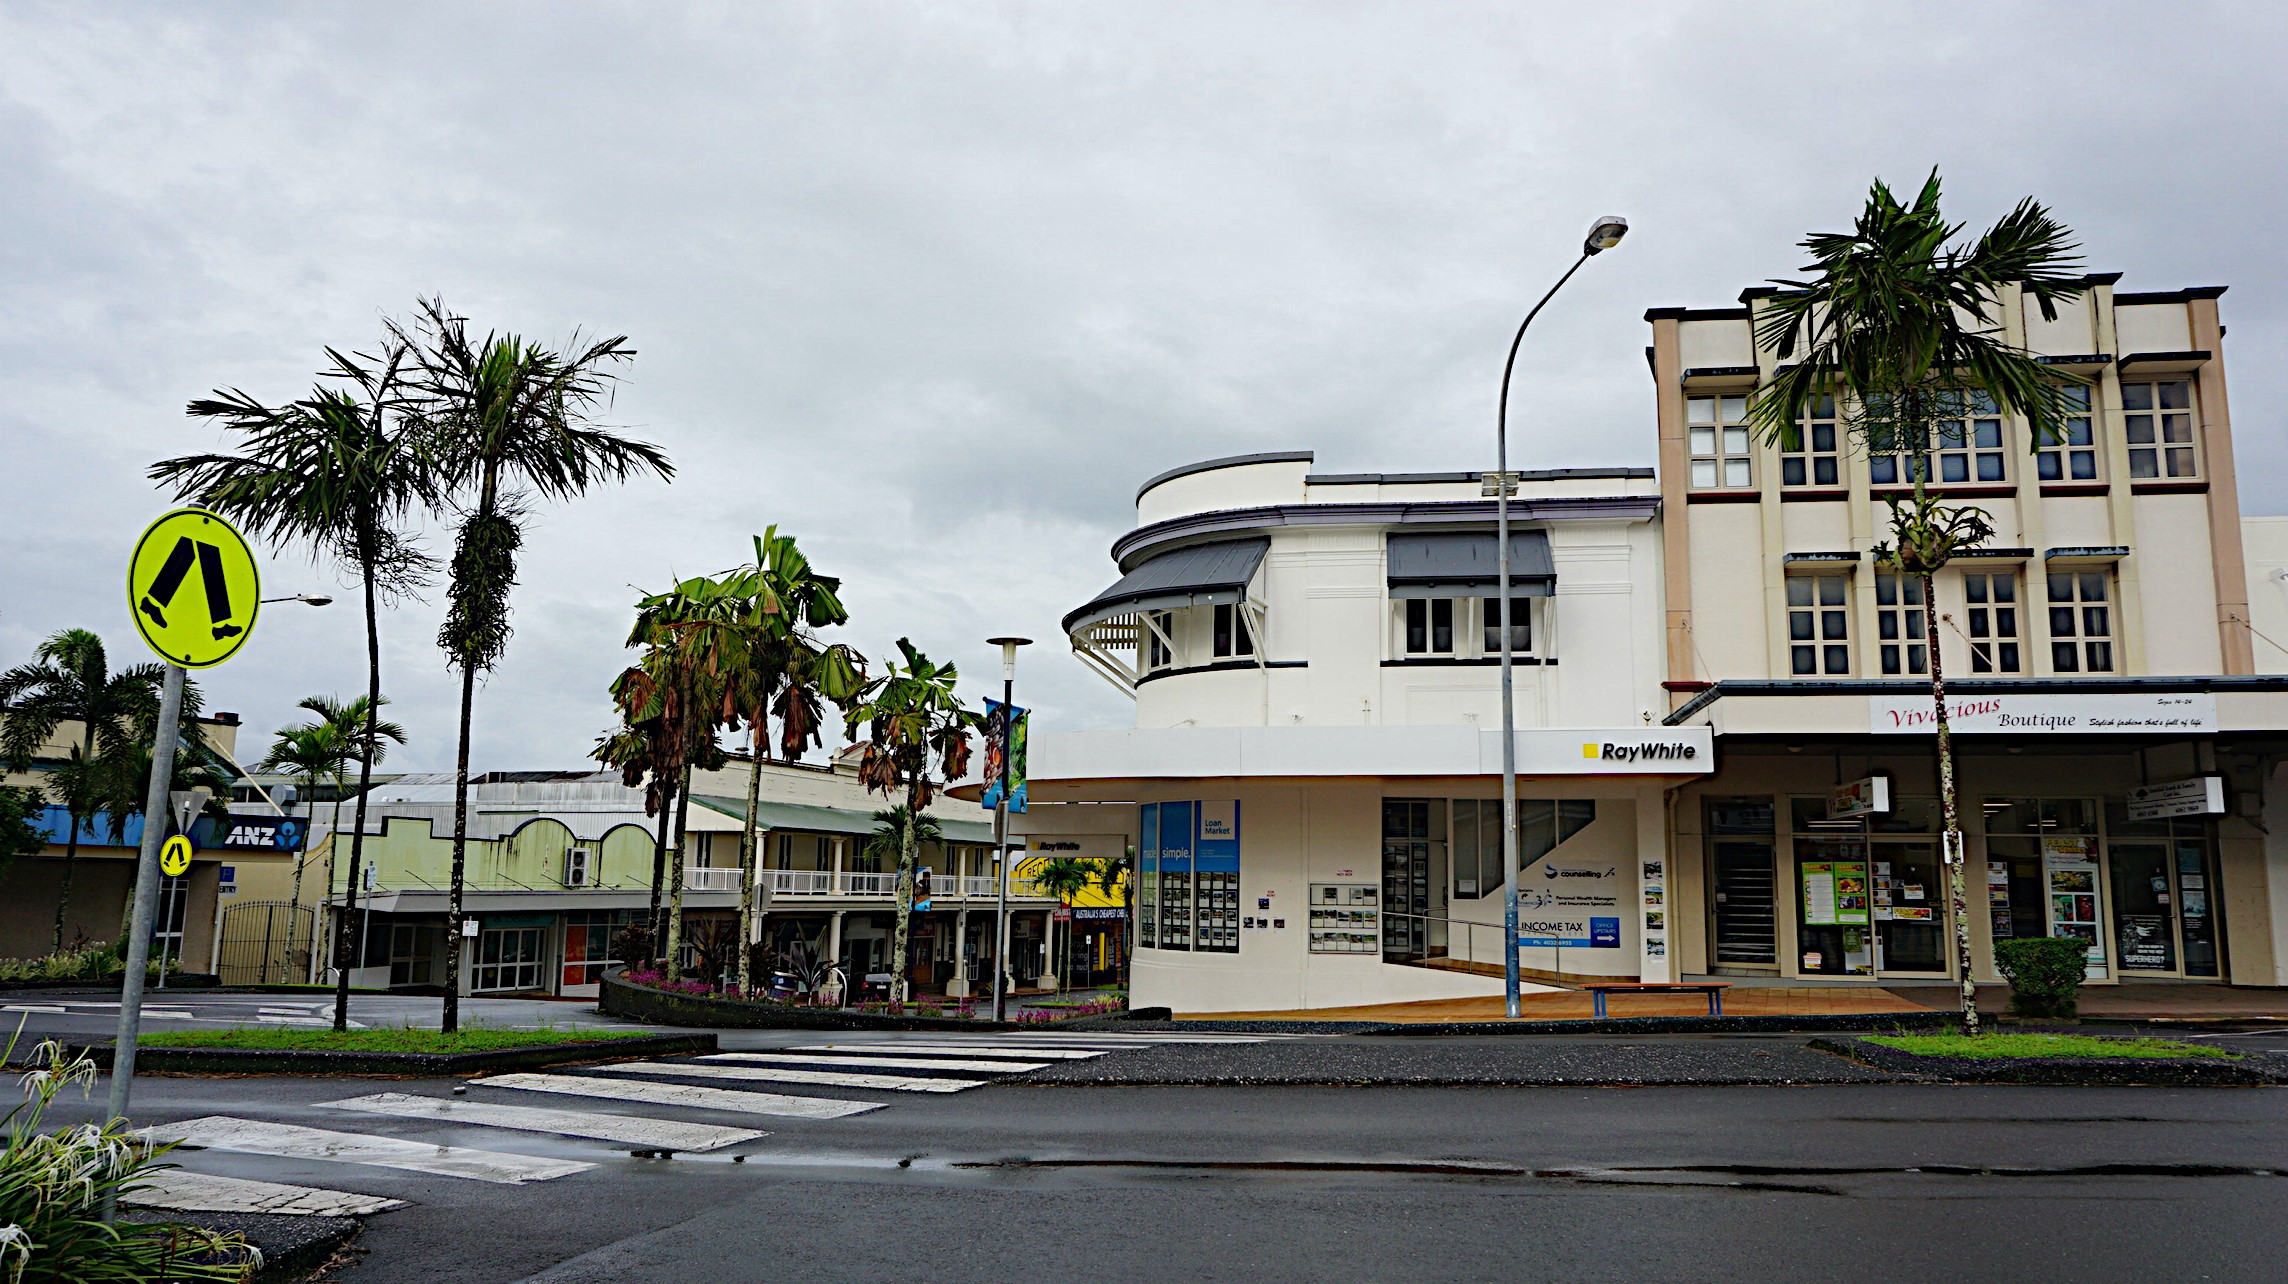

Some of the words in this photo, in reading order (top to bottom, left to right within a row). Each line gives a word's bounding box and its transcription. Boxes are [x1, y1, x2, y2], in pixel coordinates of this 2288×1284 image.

[1997, 713, 2076, 730] Boutique
[2116, 718, 2142, 728] fashion
[1205, 819, 1222, 827] Loan
[224, 825, 275, 846] ANZ
[1205, 827, 1230, 835] Market
[1162, 847, 1190, 861] simple.
[1560, 870, 1602, 879] counselling
[1099, 909, 1117, 919] CHEAPEST
[1521, 922, 1563, 932] INCOME
[1565, 922, 1583, 932] TAX
[2125, 955, 2165, 964] SUPERHERO?
